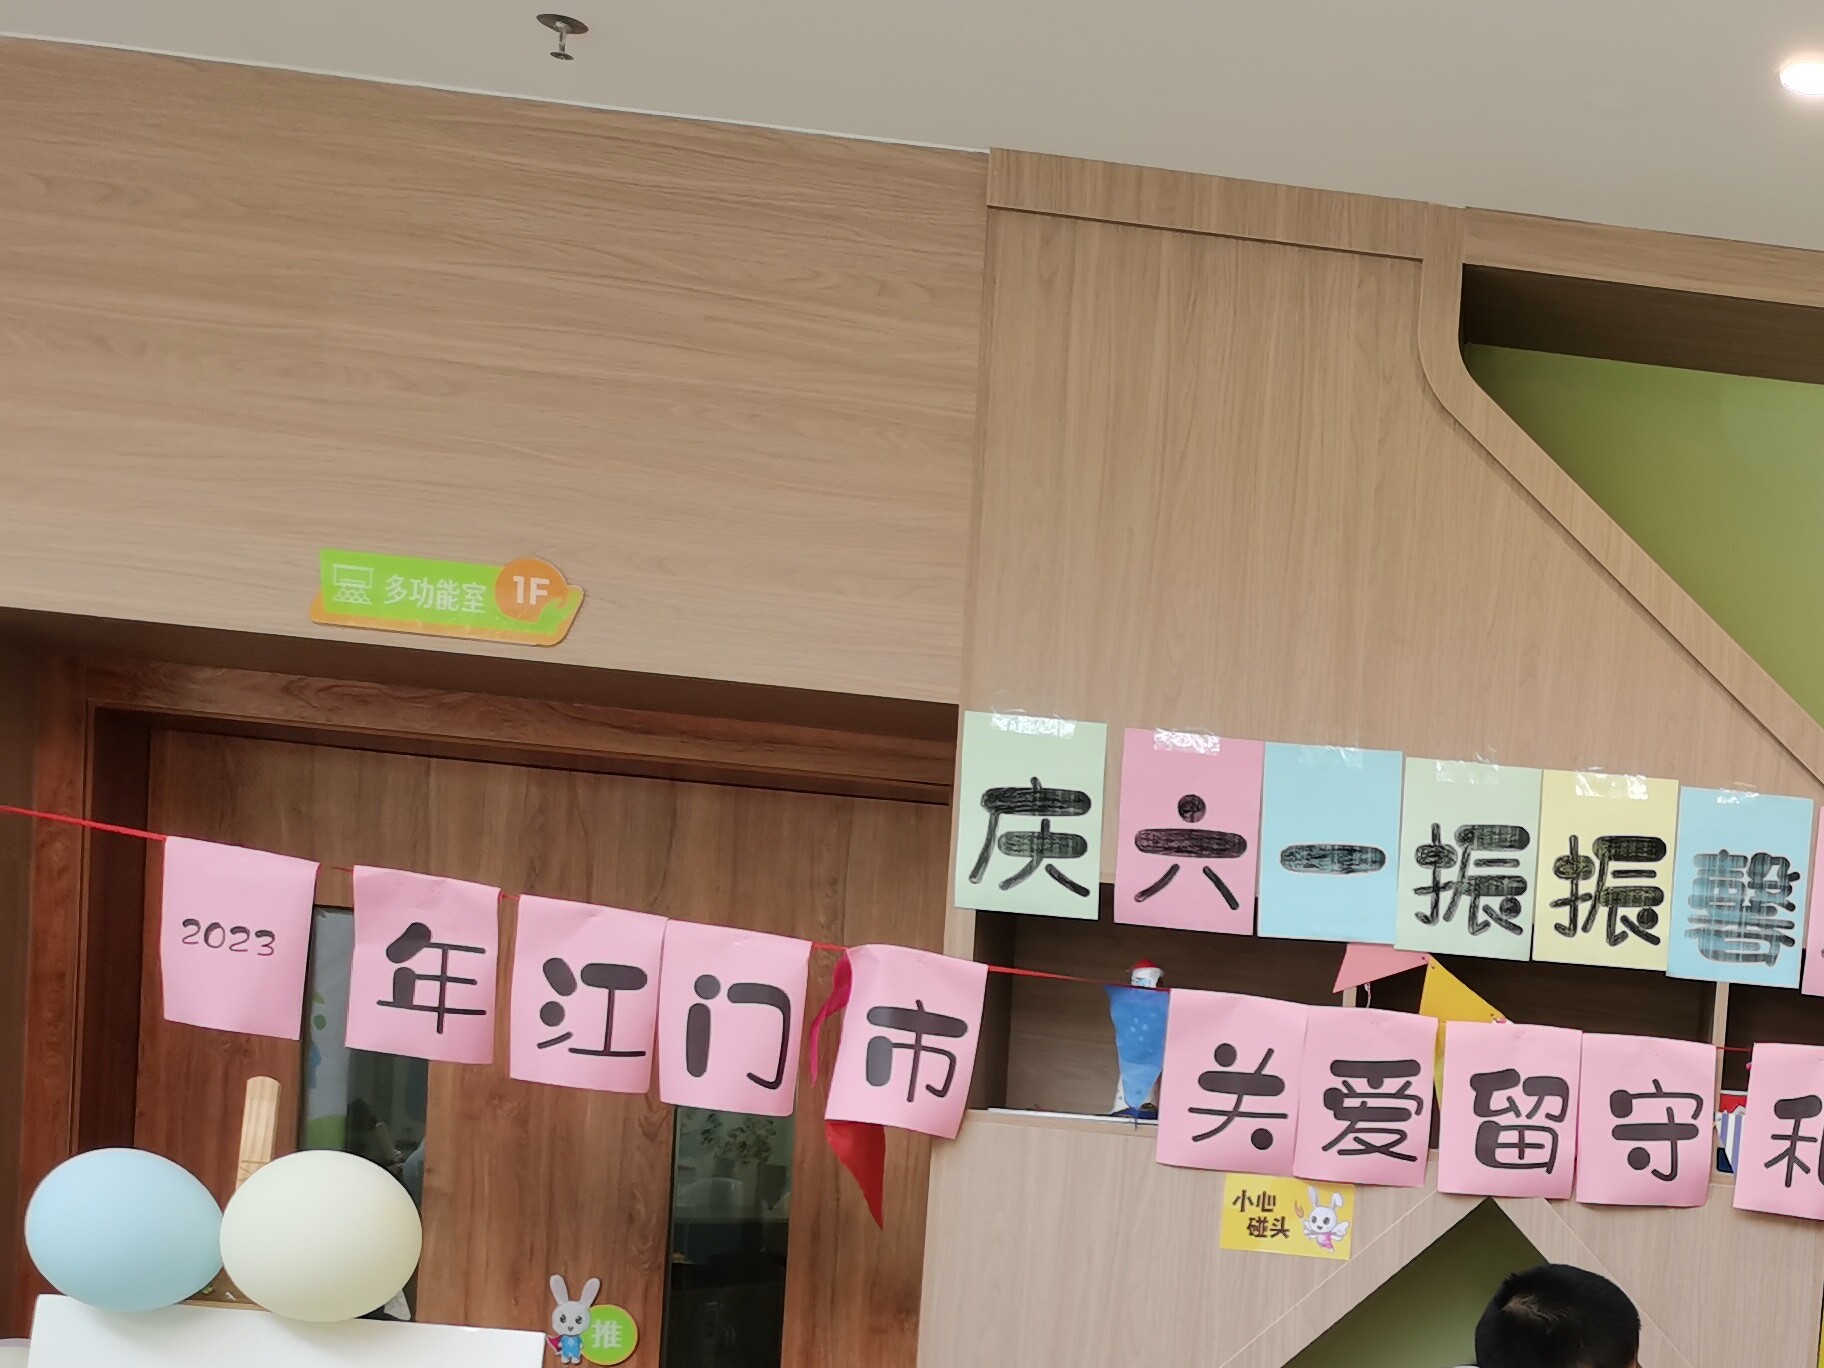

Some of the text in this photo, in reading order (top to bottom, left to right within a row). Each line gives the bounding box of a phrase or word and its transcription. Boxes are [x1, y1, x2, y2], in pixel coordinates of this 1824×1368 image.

[384, 573, 550, 615] 多功能室 1F
[1232, 1189, 1277, 1213] 小心
[1246, 1215, 1291, 1239] 碰头
[590, 1318, 623, 1350] 推
